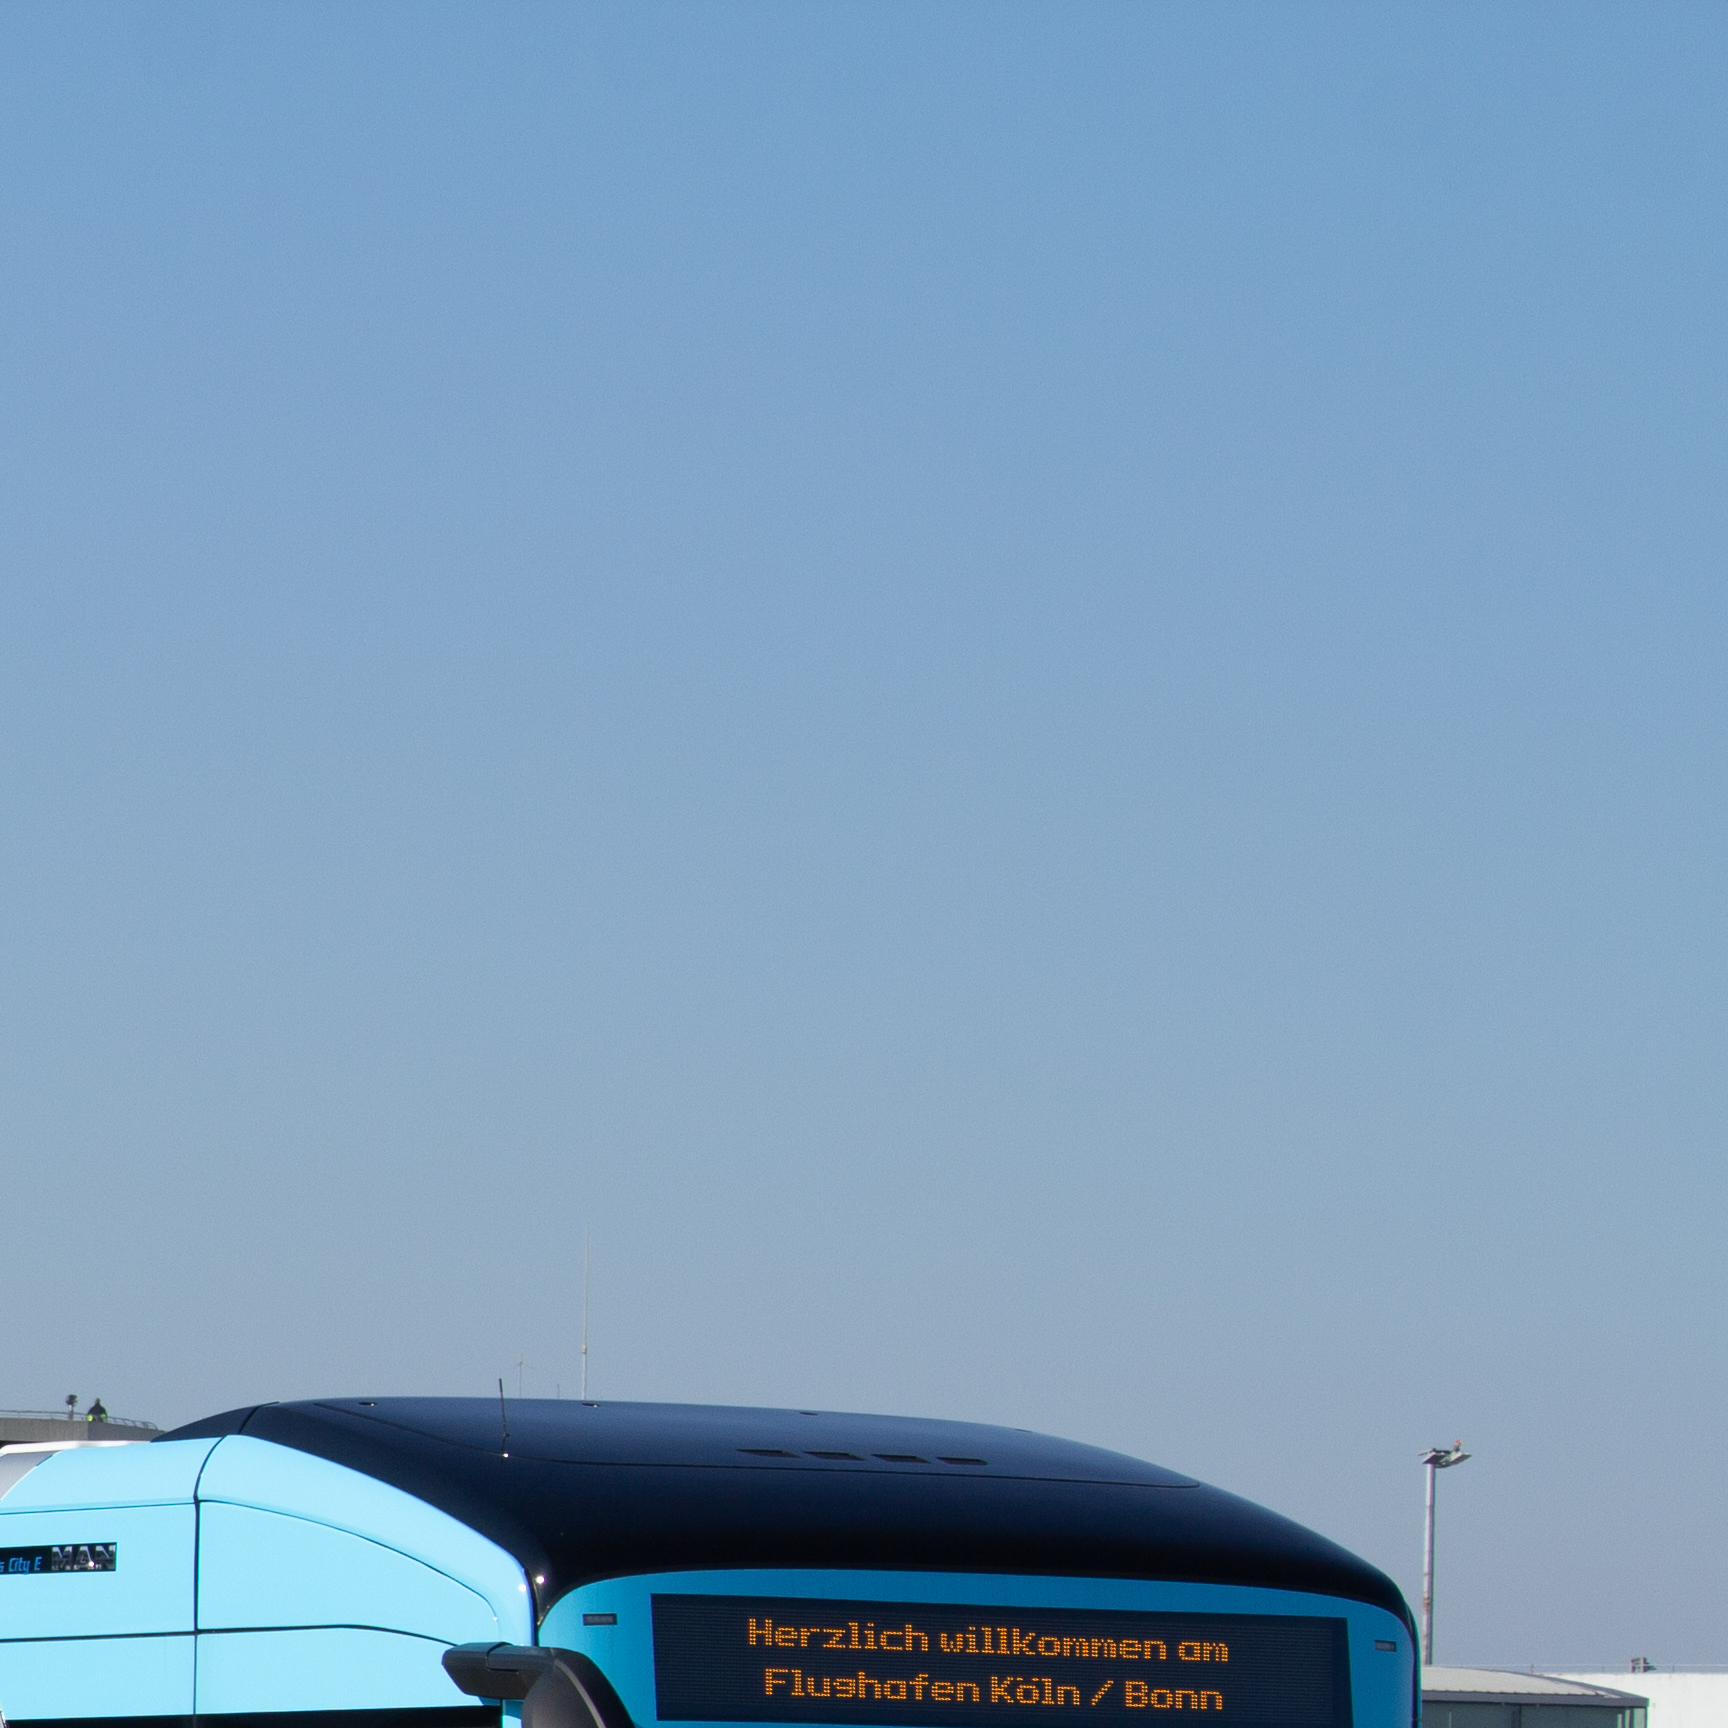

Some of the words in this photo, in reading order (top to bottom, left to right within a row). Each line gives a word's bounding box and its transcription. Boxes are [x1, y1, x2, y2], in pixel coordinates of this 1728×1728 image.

[8, 1556, 31, 1575] City
[34, 1556, 43, 1571] E
[51, 1545, 117, 1571] MAN
[748, 1618, 929, 1652] Herzlich
[940, 1626, 1167, 1660] willkommen
[1178, 1641, 1229, 1662] am
[991, 1676, 1080, 1706] Köln
[1091, 1680, 1114, 1706] /
[1125, 1680, 1223, 1710] Bonn
